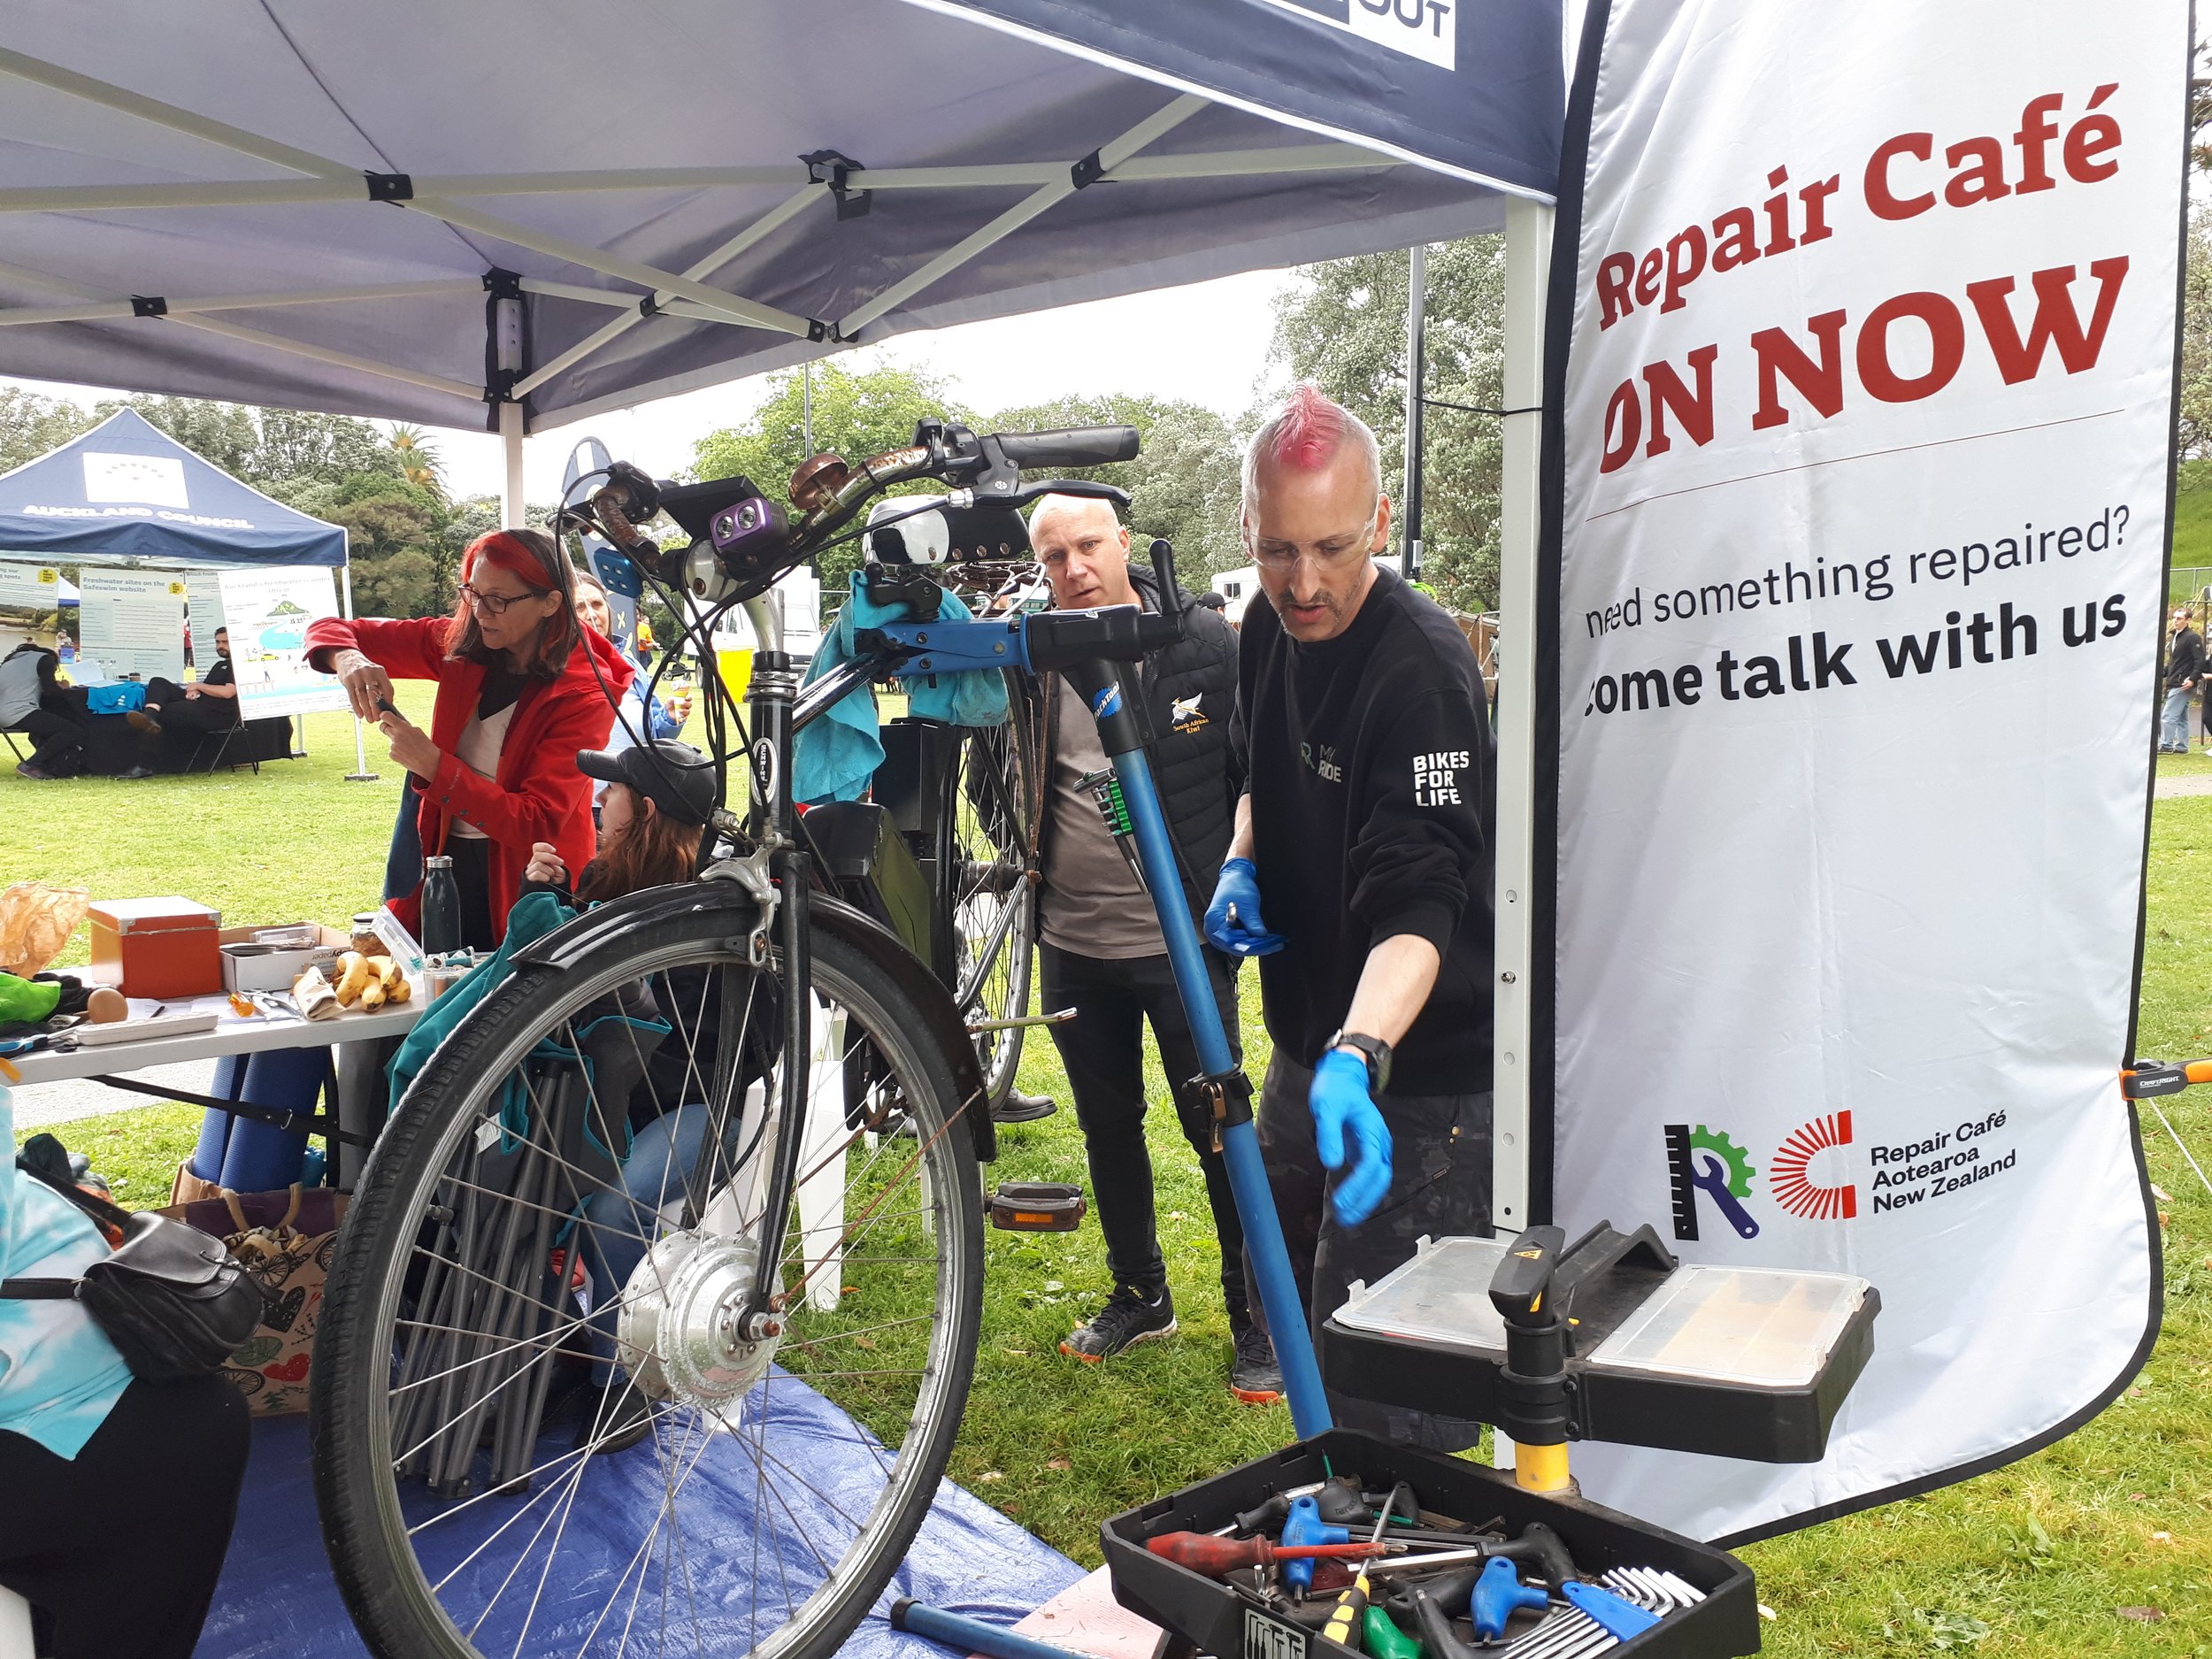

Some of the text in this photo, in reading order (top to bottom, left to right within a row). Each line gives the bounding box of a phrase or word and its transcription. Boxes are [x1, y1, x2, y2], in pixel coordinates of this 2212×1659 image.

[1596, 84, 2122, 330] Repair Café
[1600, 256, 2129, 473] ON NOW
[21, 503, 255, 529] AUCKLAND COUNCIL
[1586, 504, 2130, 639] need something repaired?
[1716, 632, 1858, 701] talk
[1876, 603, 2037, 679] with
[2062, 594, 2126, 648] us
[1173, 718, 1209, 732] South African
[1317, 759, 1342, 783] RIDE
[1413, 751, 1470, 773] BIKES
[1415, 771, 1455, 790] FOR
[1416, 788, 1462, 807] LIFE
[1870, 1109, 2007, 1166] Repair Café
[1871, 1147, 1980, 1191] Aotearoa
[1873, 1148, 2016, 1214] New Zealand
